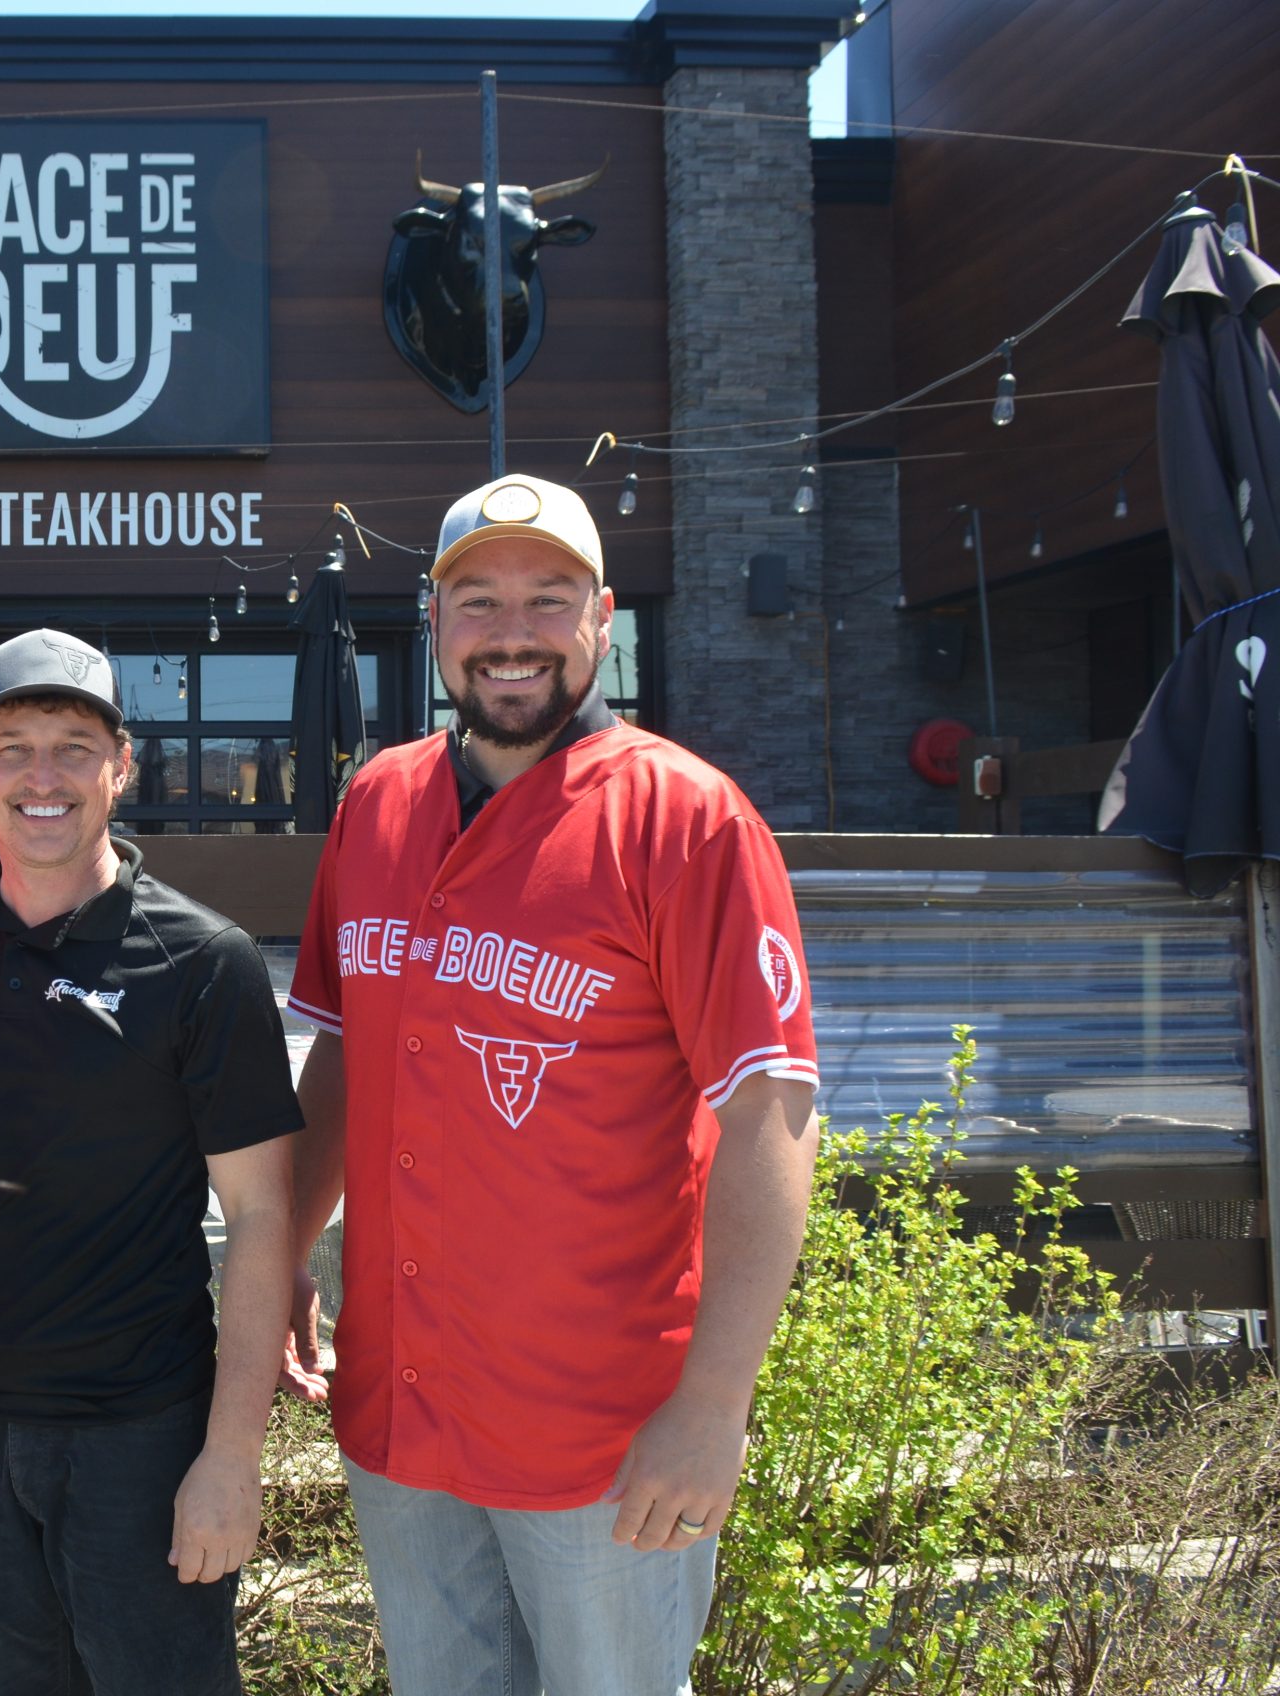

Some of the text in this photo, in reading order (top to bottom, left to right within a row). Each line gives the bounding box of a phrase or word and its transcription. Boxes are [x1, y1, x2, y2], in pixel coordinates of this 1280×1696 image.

[140, 175, 196, 232] DE
[337, 918, 615, 1022] ACE DE BOEUF
